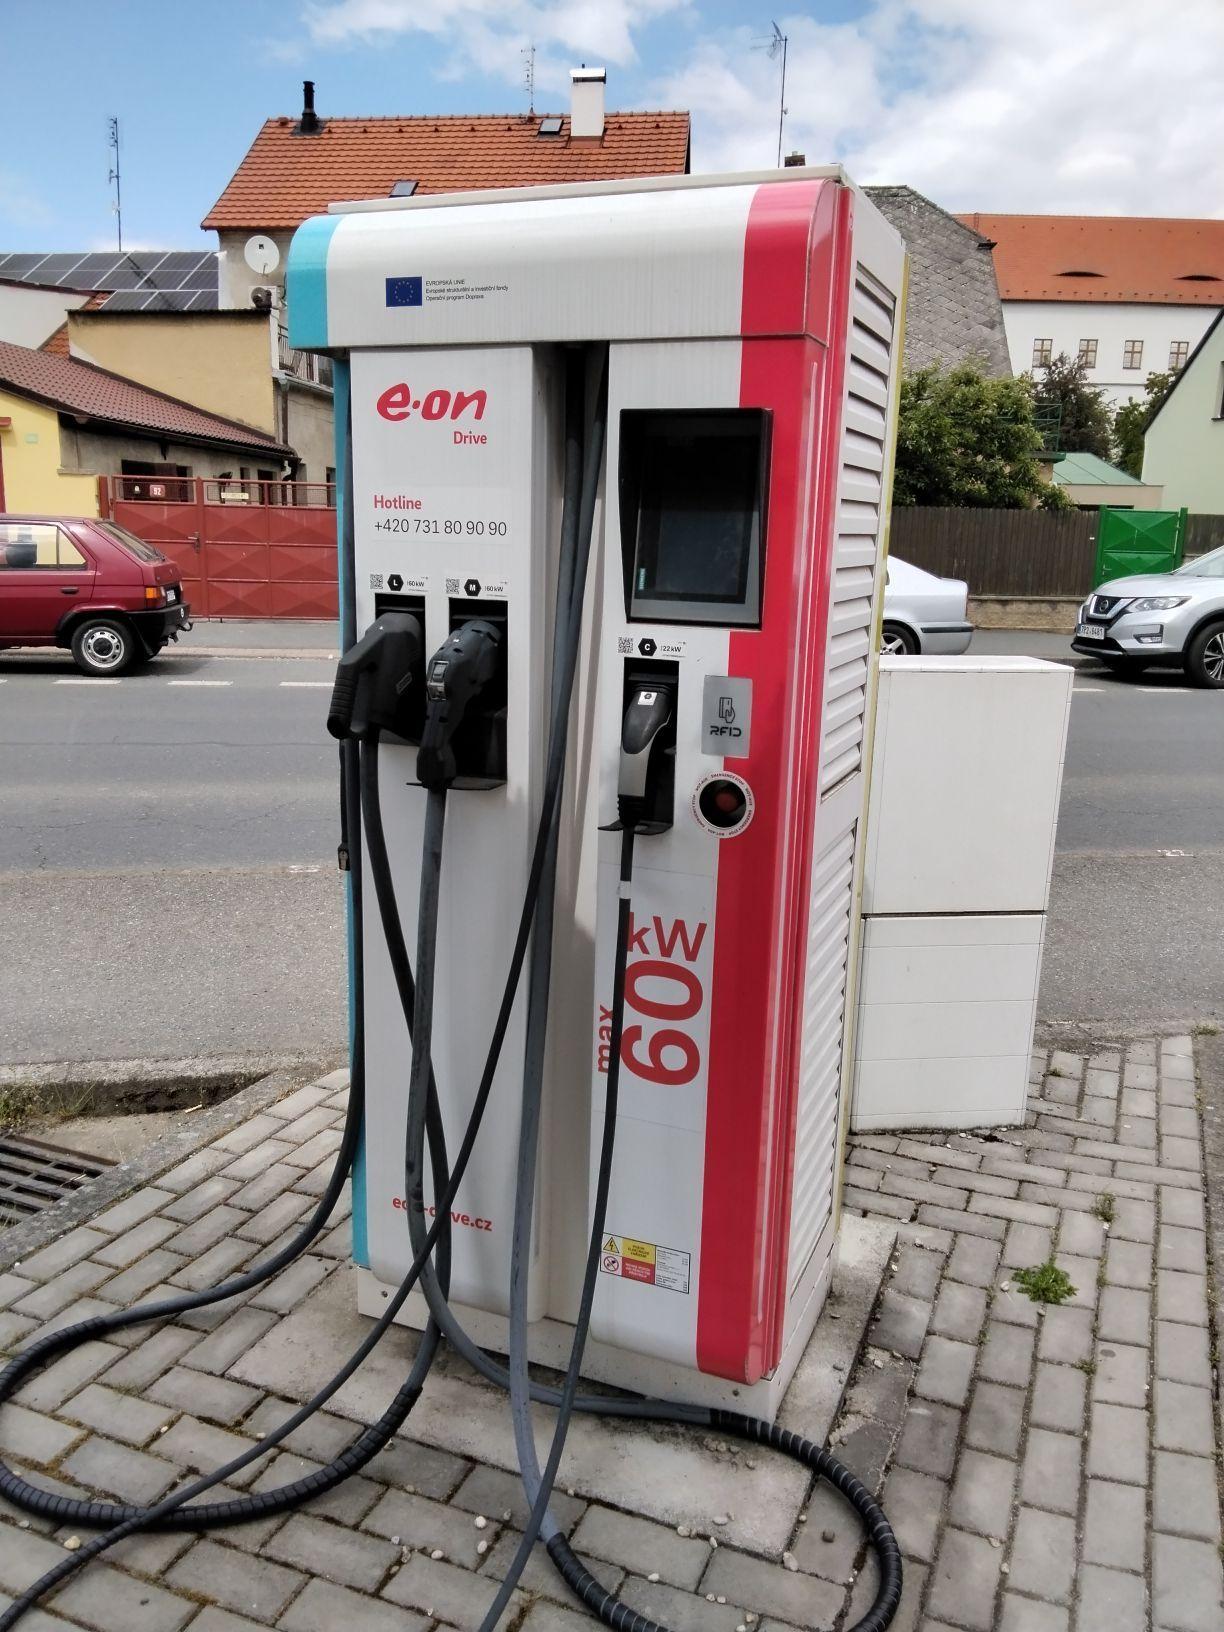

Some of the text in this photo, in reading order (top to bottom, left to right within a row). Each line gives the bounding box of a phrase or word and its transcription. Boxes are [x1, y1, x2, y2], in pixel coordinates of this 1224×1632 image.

[453, 431, 487, 444] Drive
[374, 495, 422, 509] Hotline
[374, 519, 507, 536] +420 731 80 90 90
[644, 643, 651, 651] C
[710, 725, 742, 737] RFID
[620, 911, 707, 1086] 60 kW
[598, 1005, 613, 1074] max
